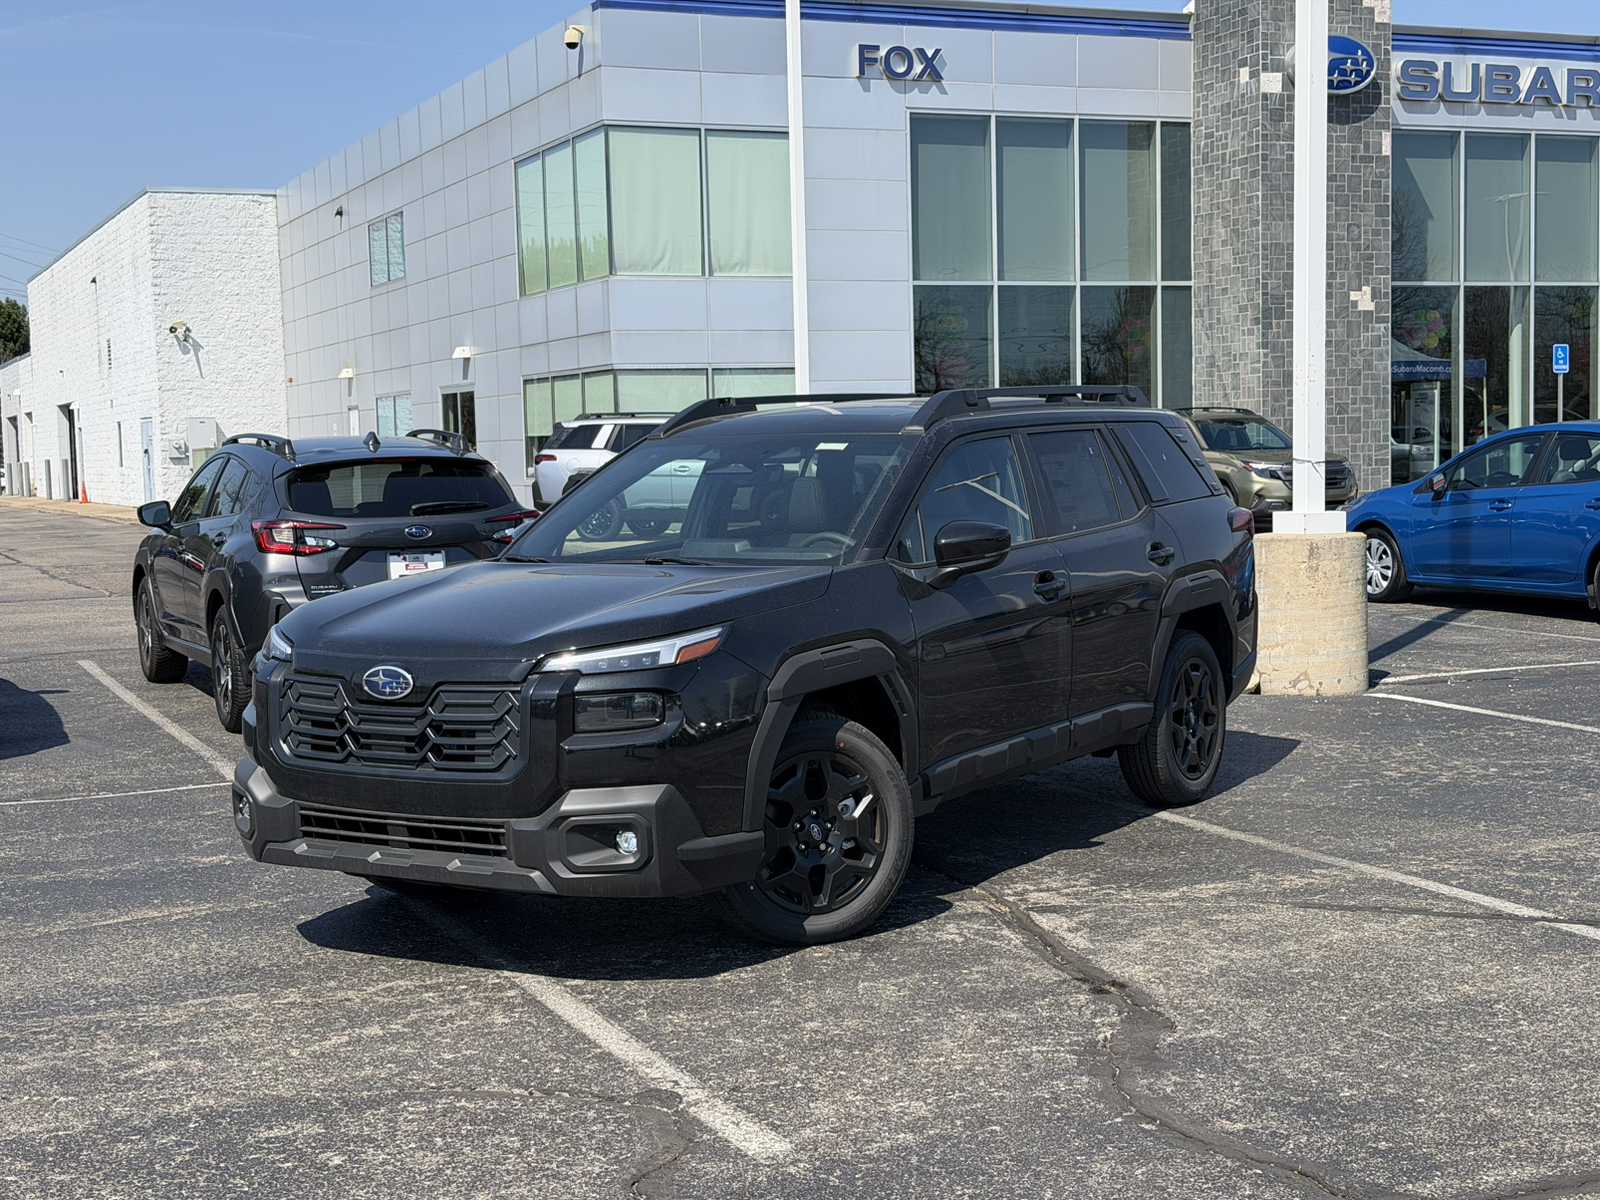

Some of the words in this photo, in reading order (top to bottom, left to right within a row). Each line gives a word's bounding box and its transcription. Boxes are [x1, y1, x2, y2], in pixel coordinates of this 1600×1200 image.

[858, 44, 944, 81] FOX
[1397, 59, 1600, 107] SUBAR
[1391, 365, 1452, 373] SubaruMacomb.co
